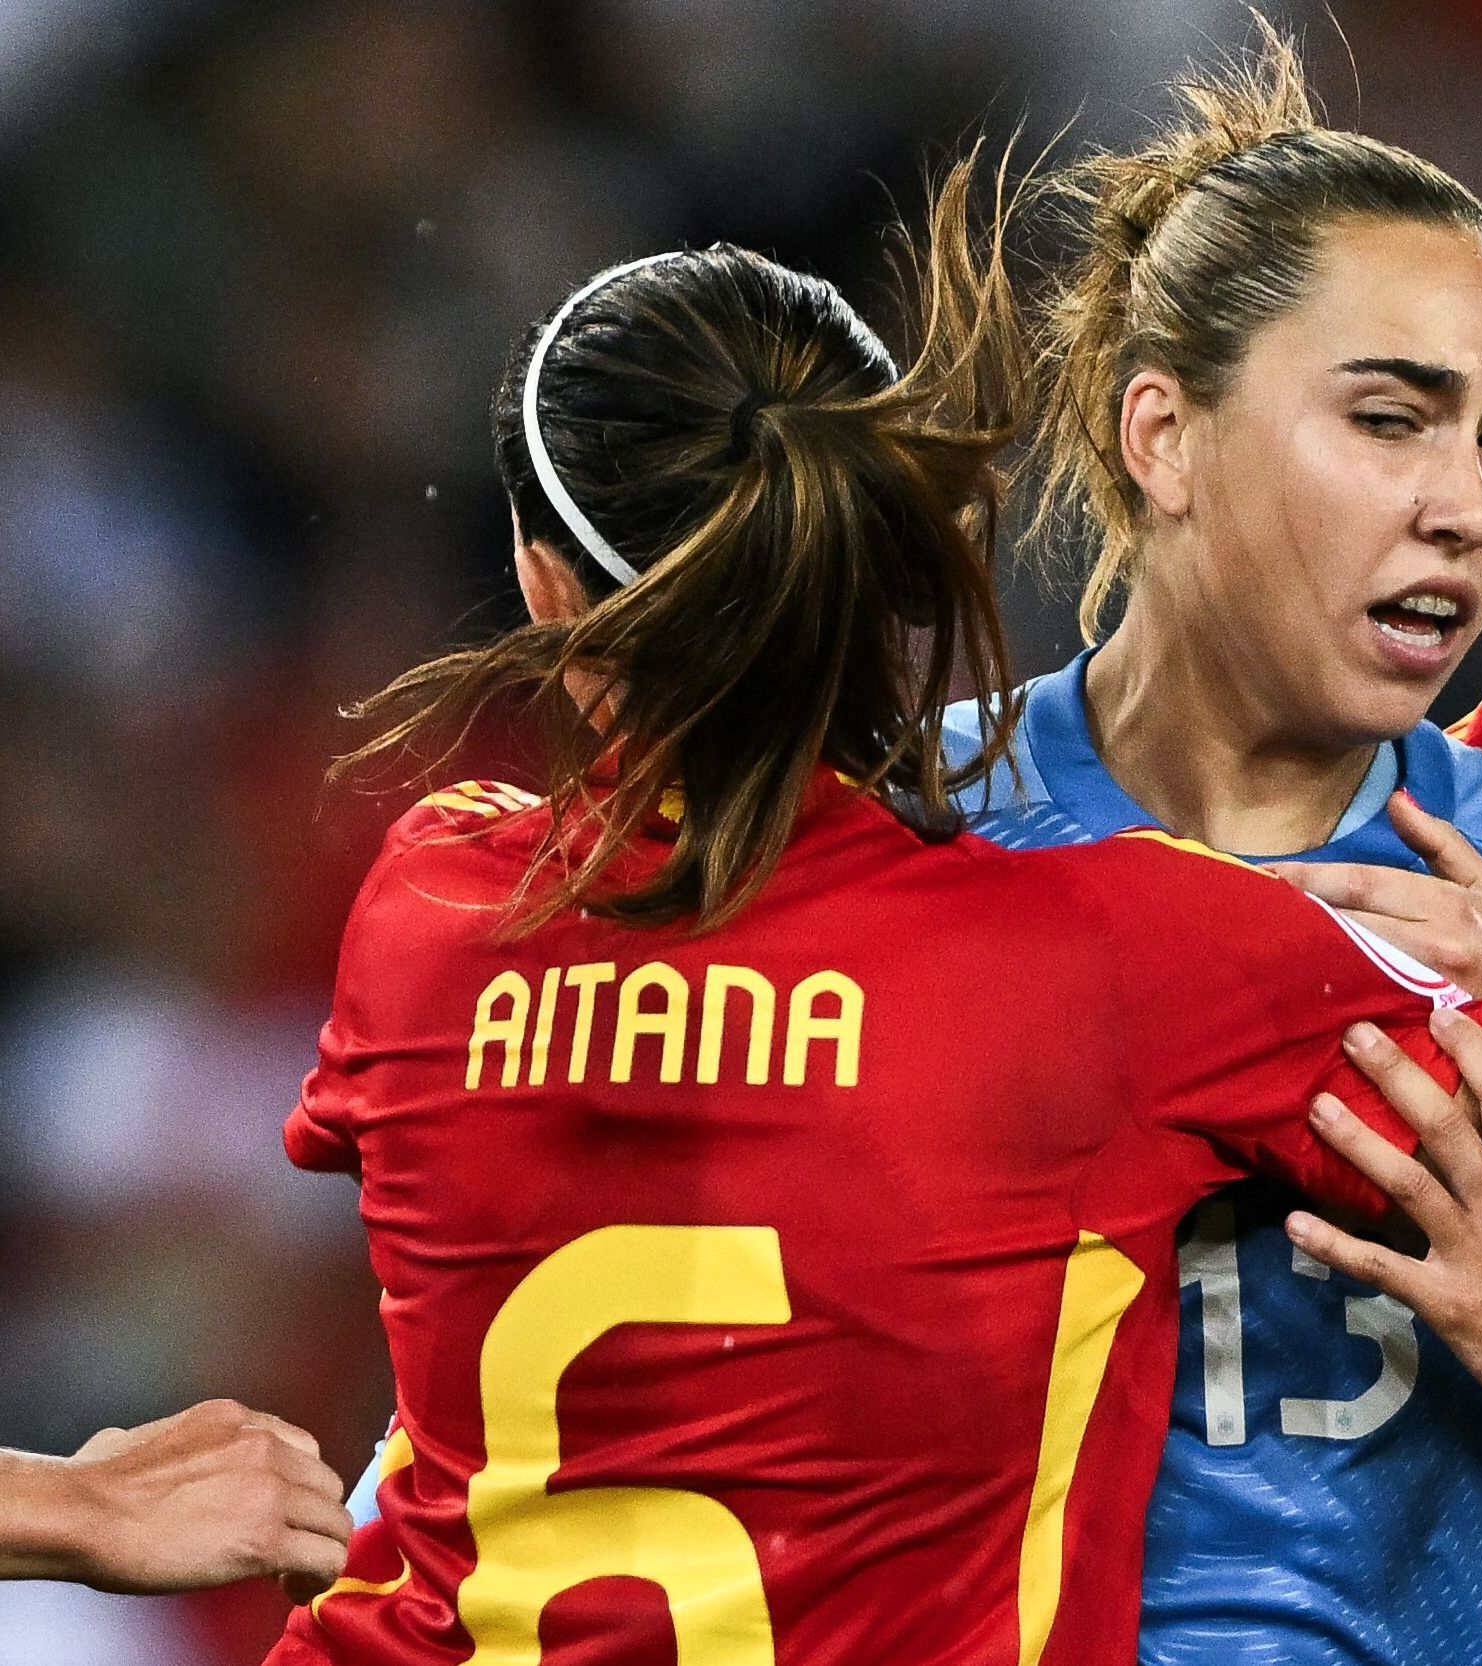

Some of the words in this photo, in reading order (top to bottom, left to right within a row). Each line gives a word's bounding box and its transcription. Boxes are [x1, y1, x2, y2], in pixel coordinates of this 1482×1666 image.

[465, 961, 865, 1090] AITANA
[457, 1224, 793, 1666] 6
[1178, 1200, 1419, 1446] 13
